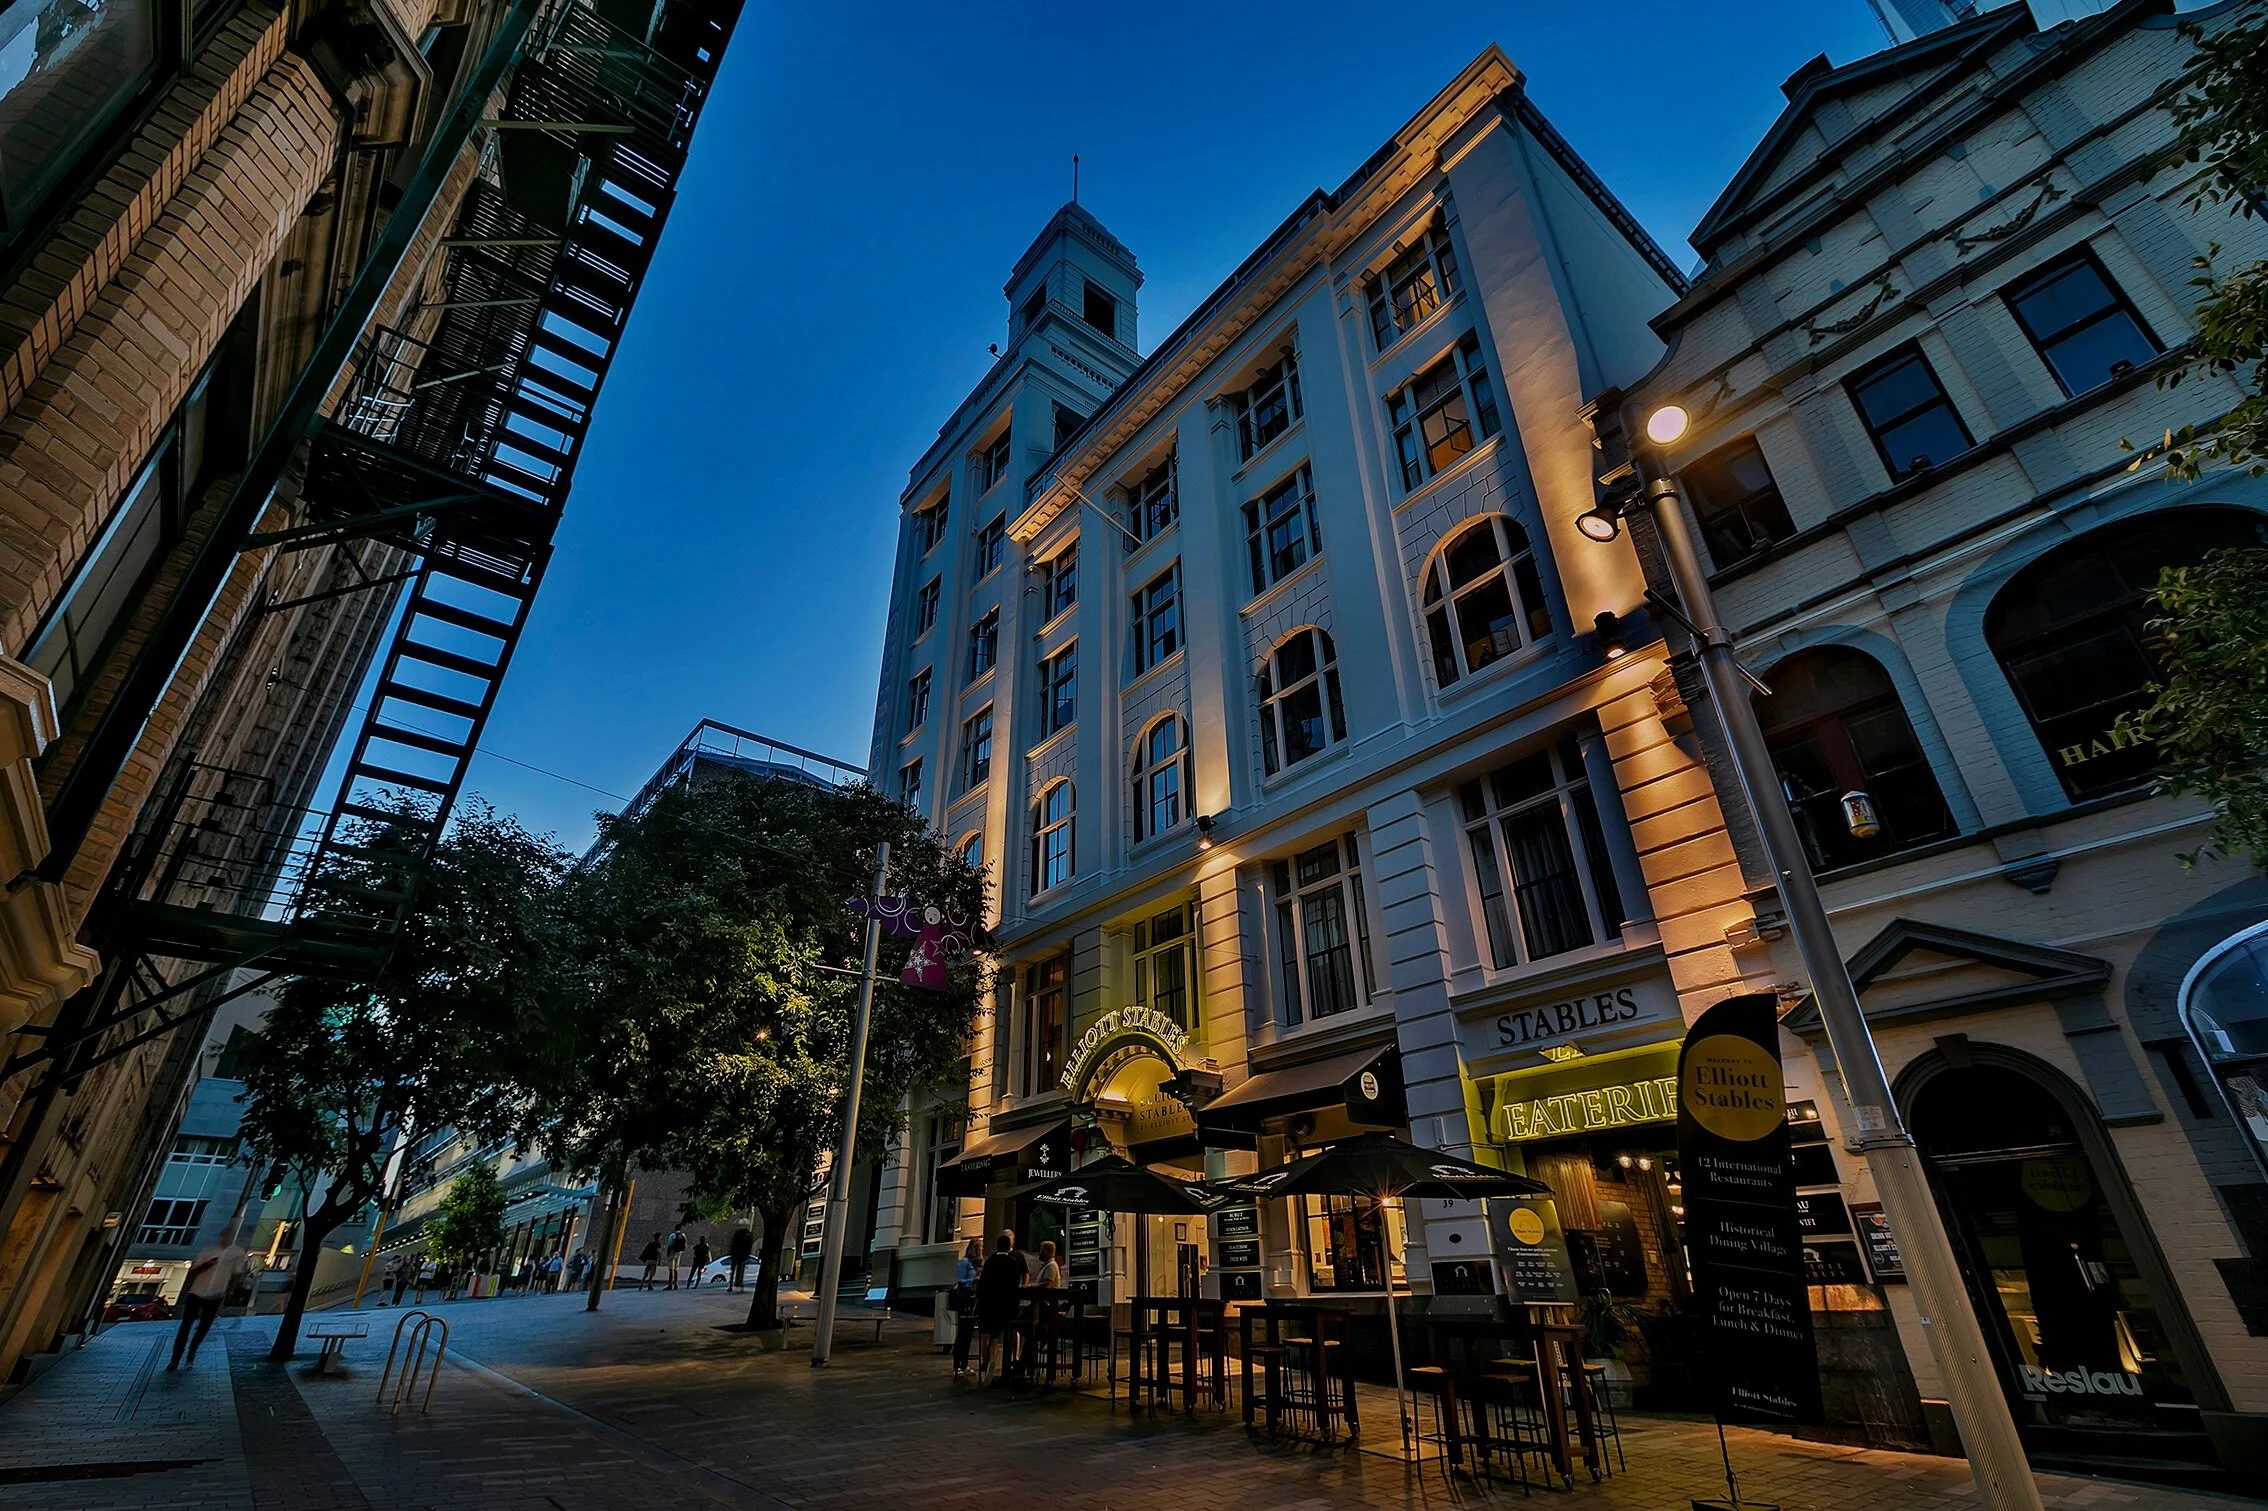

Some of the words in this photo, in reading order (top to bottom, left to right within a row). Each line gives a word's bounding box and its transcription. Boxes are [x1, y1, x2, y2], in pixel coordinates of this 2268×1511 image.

[1497, 988, 1638, 1045] STABLES
[1059, 1010, 1121, 1092] ELLIOTT
[1122, 1005, 1190, 1055] STABLES
[1695, 1066, 1768, 1088] Elliott
[1695, 1087, 1775, 1111] Stables
[1698, 1156, 1711, 1168] 12
[1713, 1157, 1782, 1176] International
[1710, 1171, 1773, 1188] Restaurants
[1443, 1199, 1454, 1208] 39
[1720, 1221, 1775, 1239] Historical
[1709, 1234, 1748, 1252] Dining
[1750, 1239, 1788, 1257] Village
[1718, 1301, 1735, 1313] for
[1719, 1286, 1750, 1302] Open
[1752, 1290, 1760, 1301] 7
[1763, 1291, 1792, 1309] Days
[1712, 1314, 1748, 1330] Lunch
[1750, 1320, 1760, 1332] &
[1764, 1322, 1804, 1340] Dinner
[2017, 1364, 2144, 1396] Reslau
[1732, 1386, 1761, 1400] Elliott
[1762, 1393, 1798, 1407] Stables
